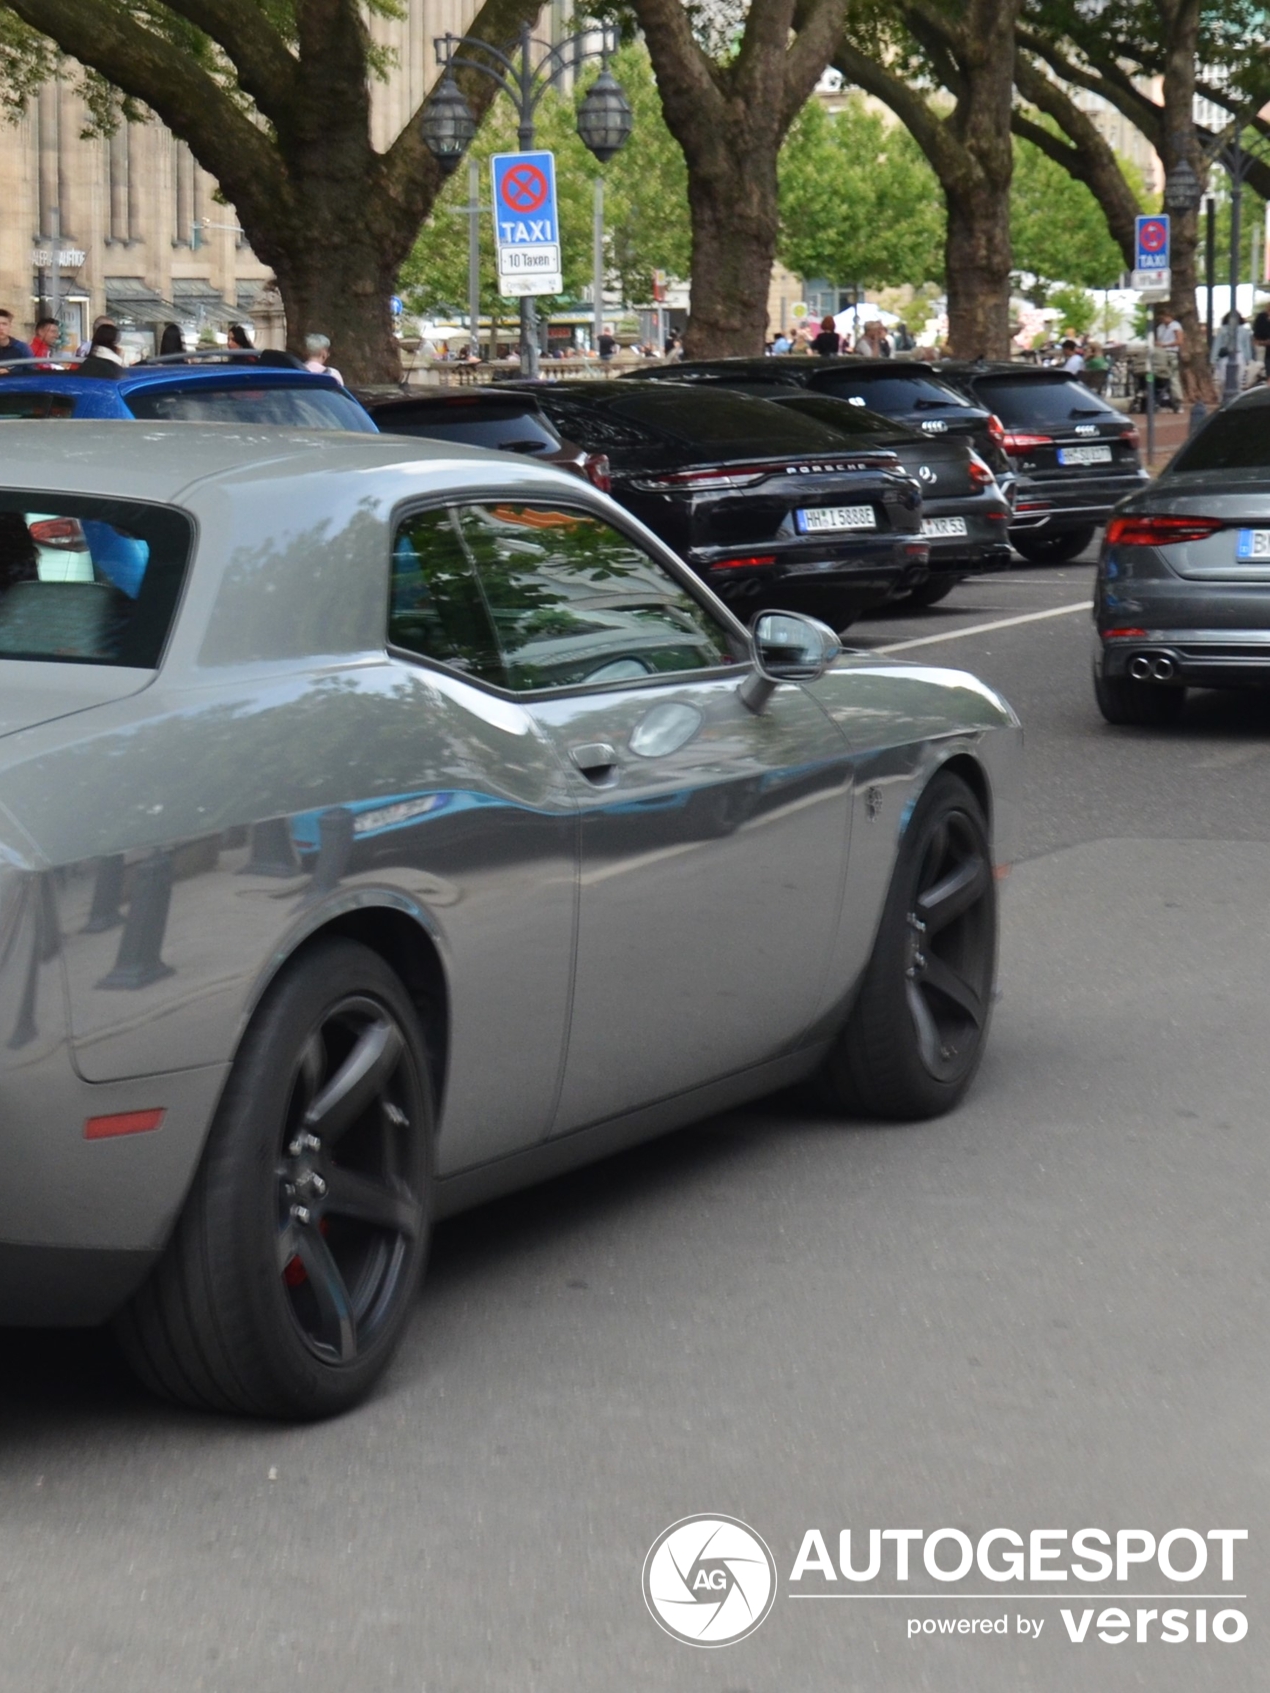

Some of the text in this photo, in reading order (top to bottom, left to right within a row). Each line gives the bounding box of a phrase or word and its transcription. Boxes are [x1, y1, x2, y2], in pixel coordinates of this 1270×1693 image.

[501, 220, 552, 243] TAXI
[509, 252, 550, 267] 10 Taxen
[1139, 254, 1166, 268] TAXI
[786, 463, 868, 474] PORSCHE
[806, 511, 822, 527] HH
[950, 518, 963, 533] 53
[1254, 533, 1270, 554] B
